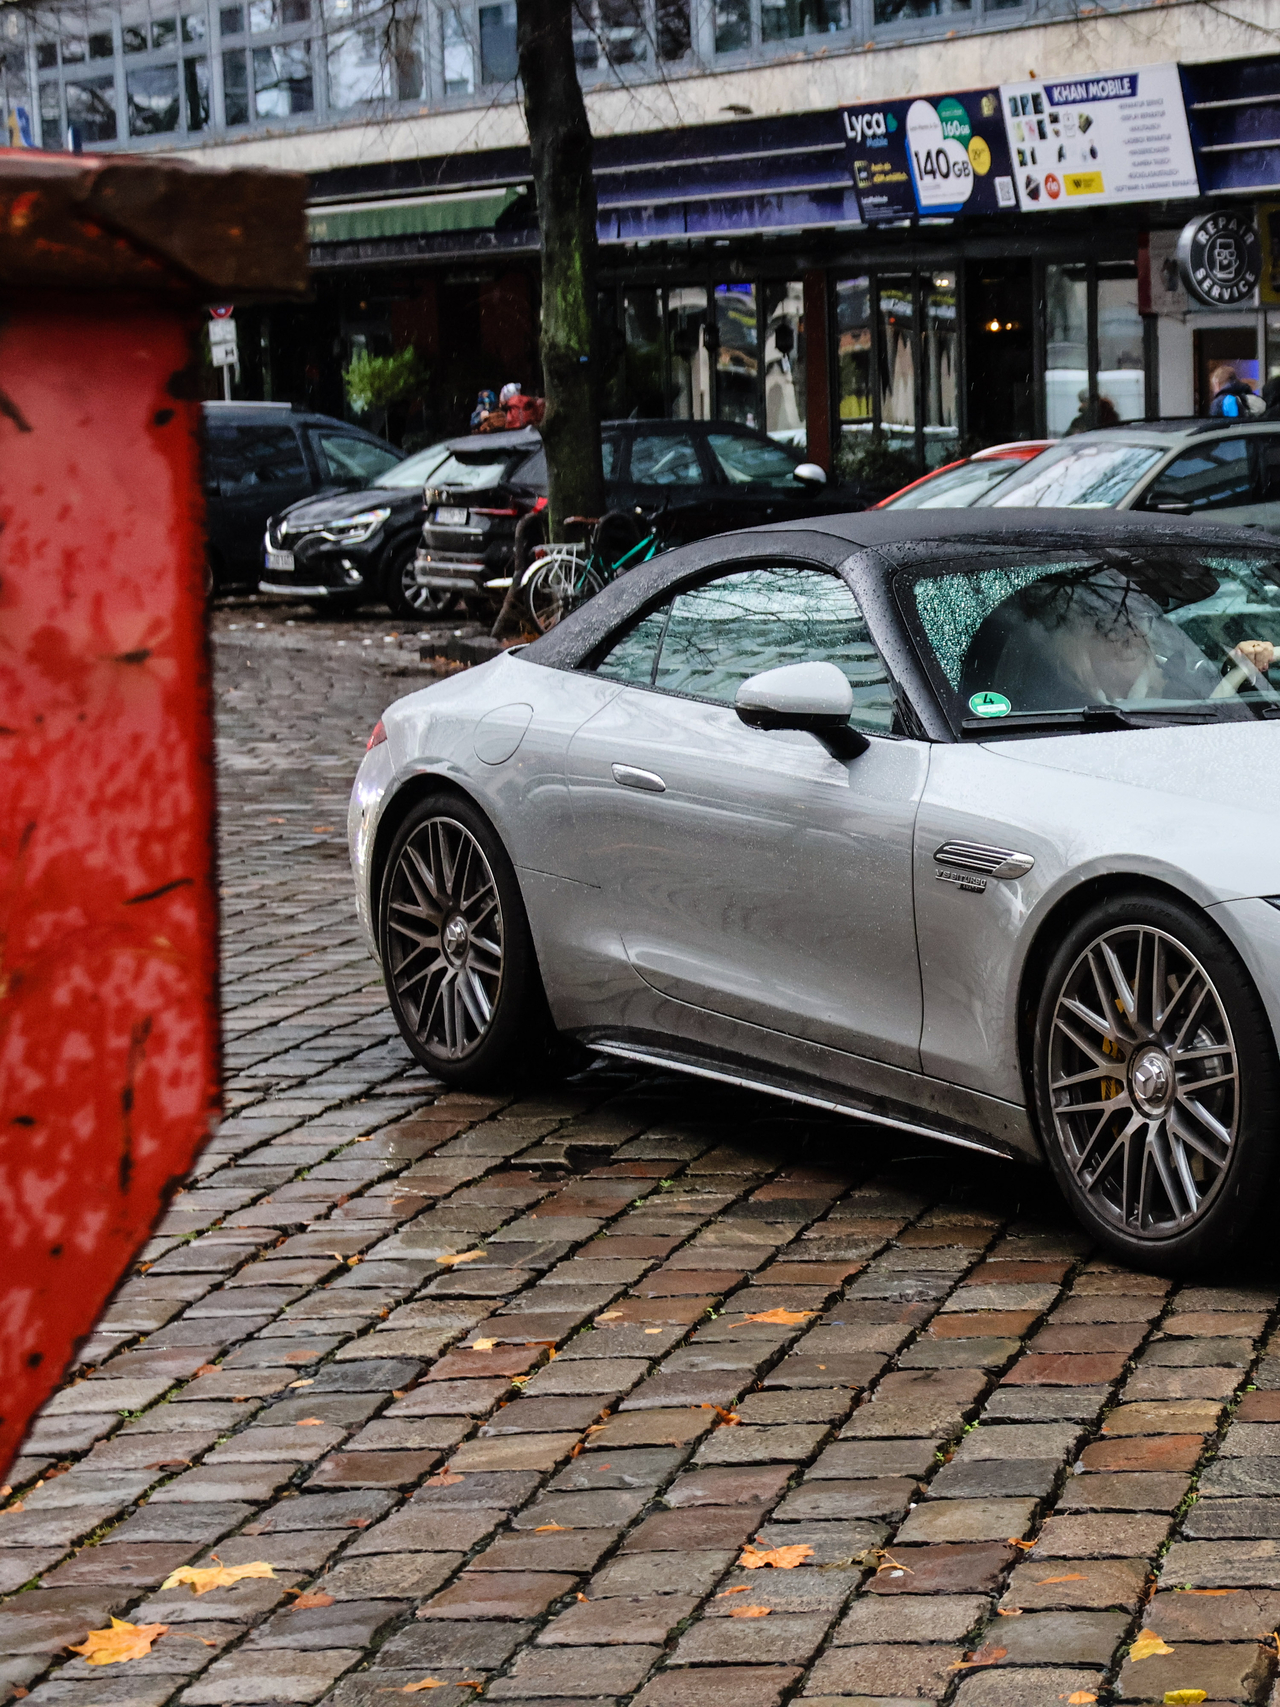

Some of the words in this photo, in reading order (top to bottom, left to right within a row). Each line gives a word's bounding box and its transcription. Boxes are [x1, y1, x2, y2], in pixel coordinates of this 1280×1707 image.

[1053, 83, 1087, 102] KHAN
[1089, 77, 1132, 98] MOBILE
[843, 111, 886, 143] Lyca
[866, 136, 889, 148] Mobile
[914, 147, 951, 181] 140
[1196, 216, 1256, 246] REPAIR
[1193, 267, 1257, 301] SERVICE
[983, 693, 995, 705] 4
[951, 872, 987, 887] BITURBO
